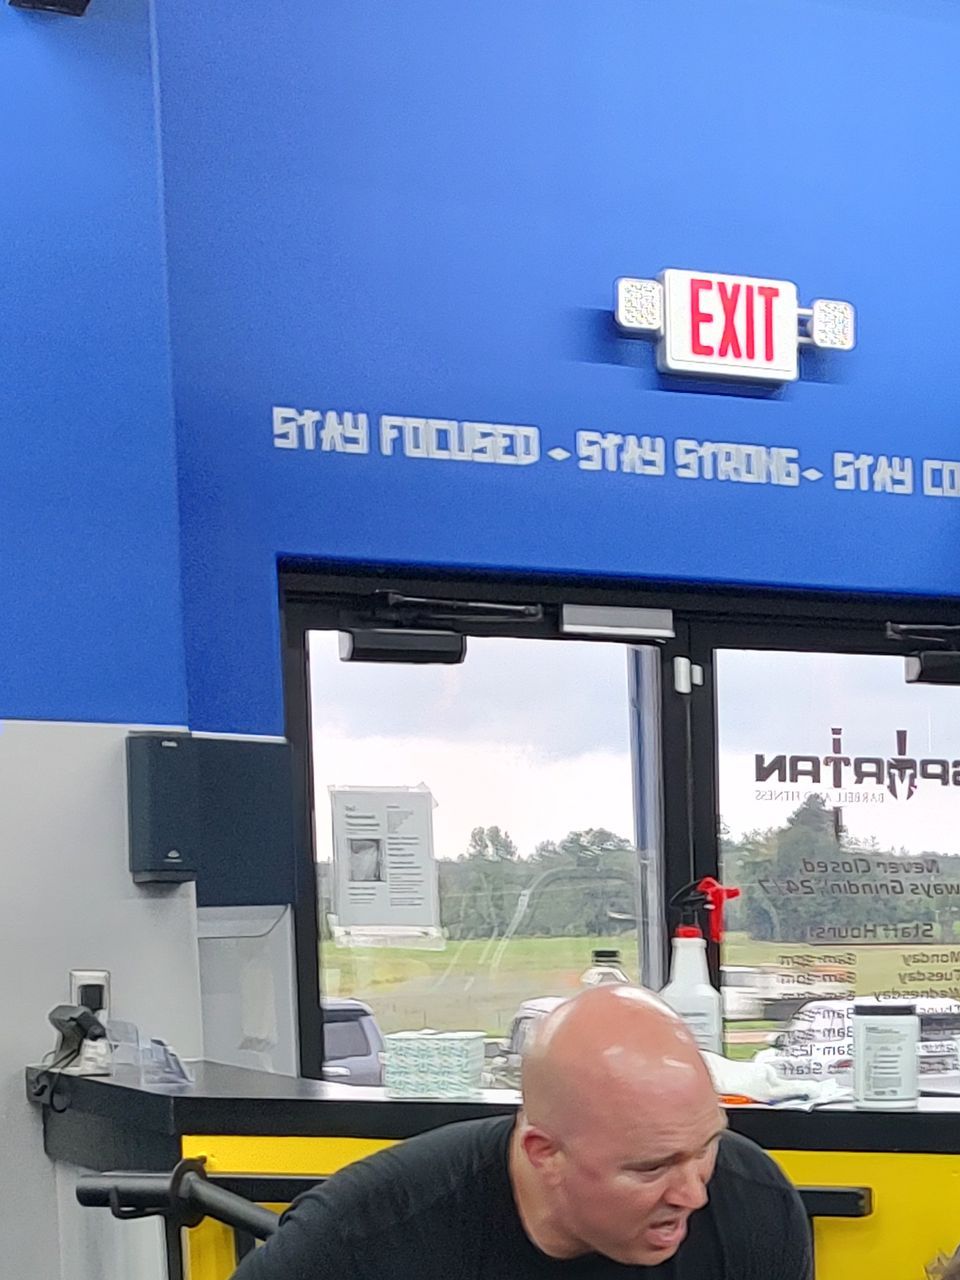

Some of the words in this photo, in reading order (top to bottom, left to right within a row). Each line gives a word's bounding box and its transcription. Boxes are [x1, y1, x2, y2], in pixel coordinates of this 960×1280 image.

[690, 277, 781, 363] EXIT
[272, 406, 369, 454] STAY
[380, 414, 541, 466] FOCUSED
[576, 429, 666, 476] STAY
[674, 437, 800, 487] STRONG
[833, 451, 914, 495] STAY
